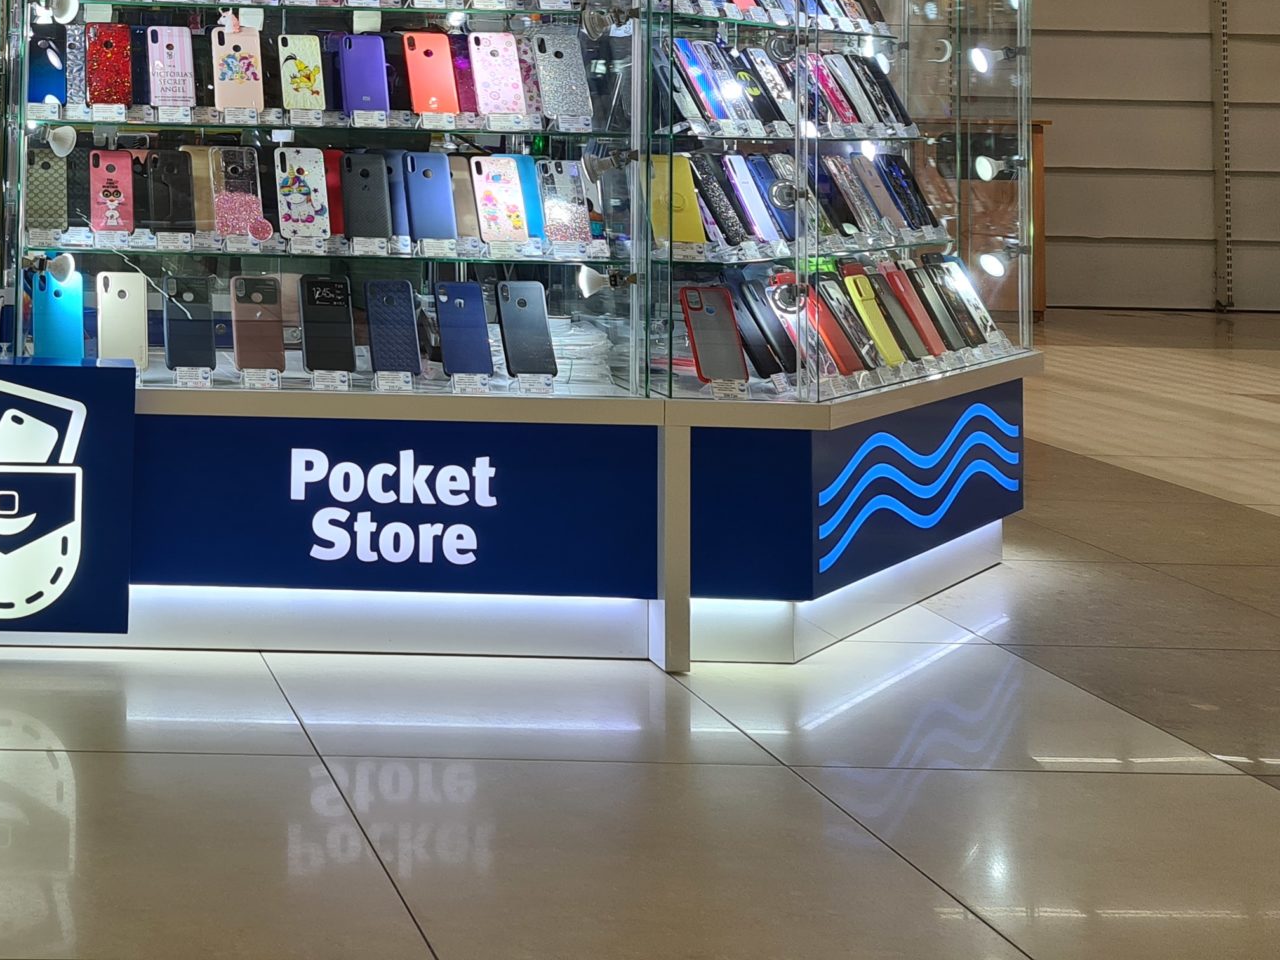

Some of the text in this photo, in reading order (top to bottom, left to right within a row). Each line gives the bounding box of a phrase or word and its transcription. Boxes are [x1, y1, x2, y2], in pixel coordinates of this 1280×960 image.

[158, 78, 187, 86] SECRET
[290, 447, 498, 507] Pocket
[309, 506, 478, 565] Store
